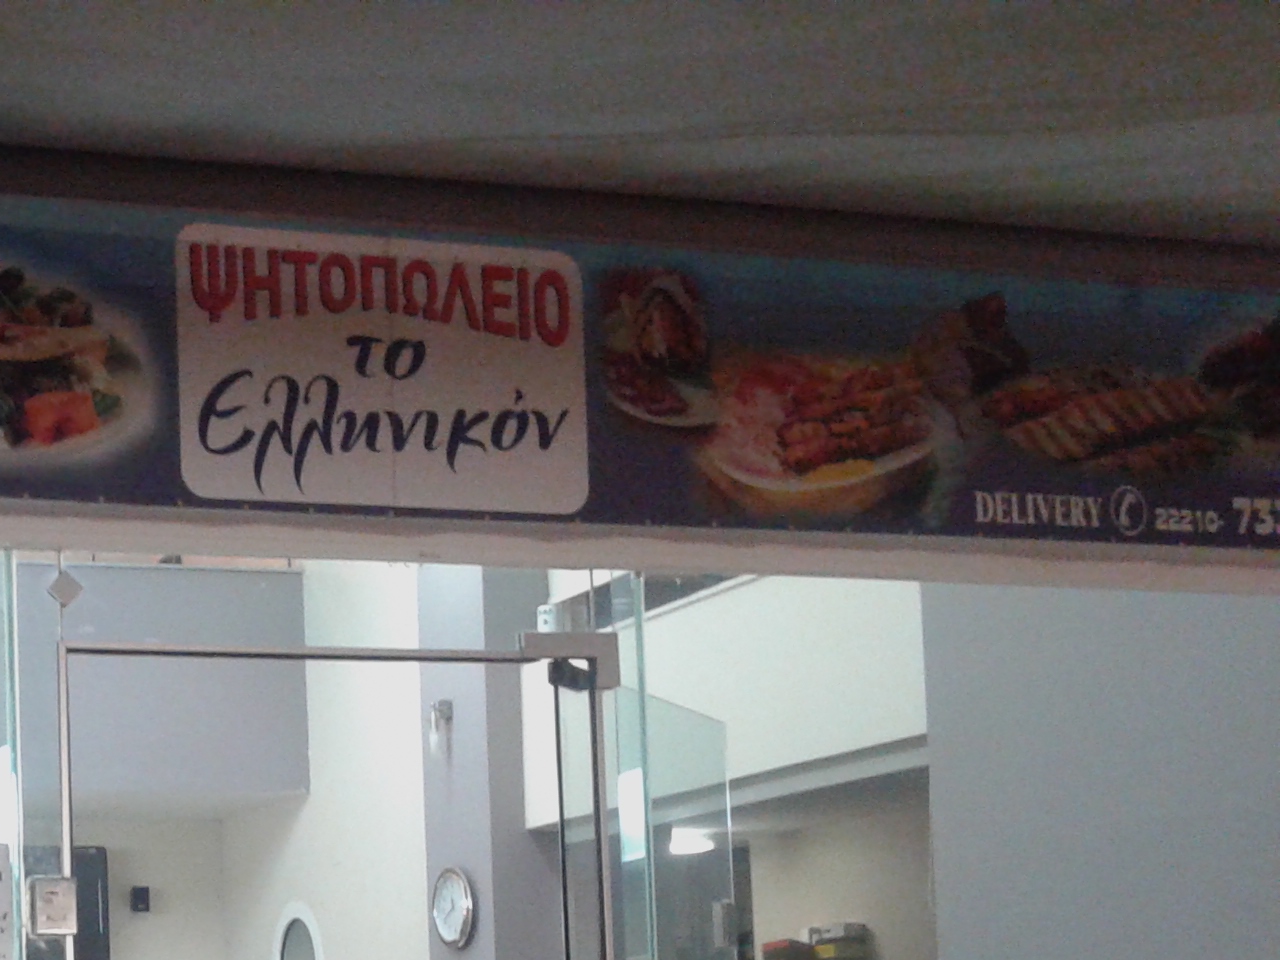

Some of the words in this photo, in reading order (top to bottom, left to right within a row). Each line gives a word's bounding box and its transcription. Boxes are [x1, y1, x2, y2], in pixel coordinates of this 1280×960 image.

[189, 243, 570, 347] ΨΗΤΟΠΩΛΕΙΟ
[974, 490, 1102, 527] DELIVERY
[1231, 497, 1280, 536] 73
